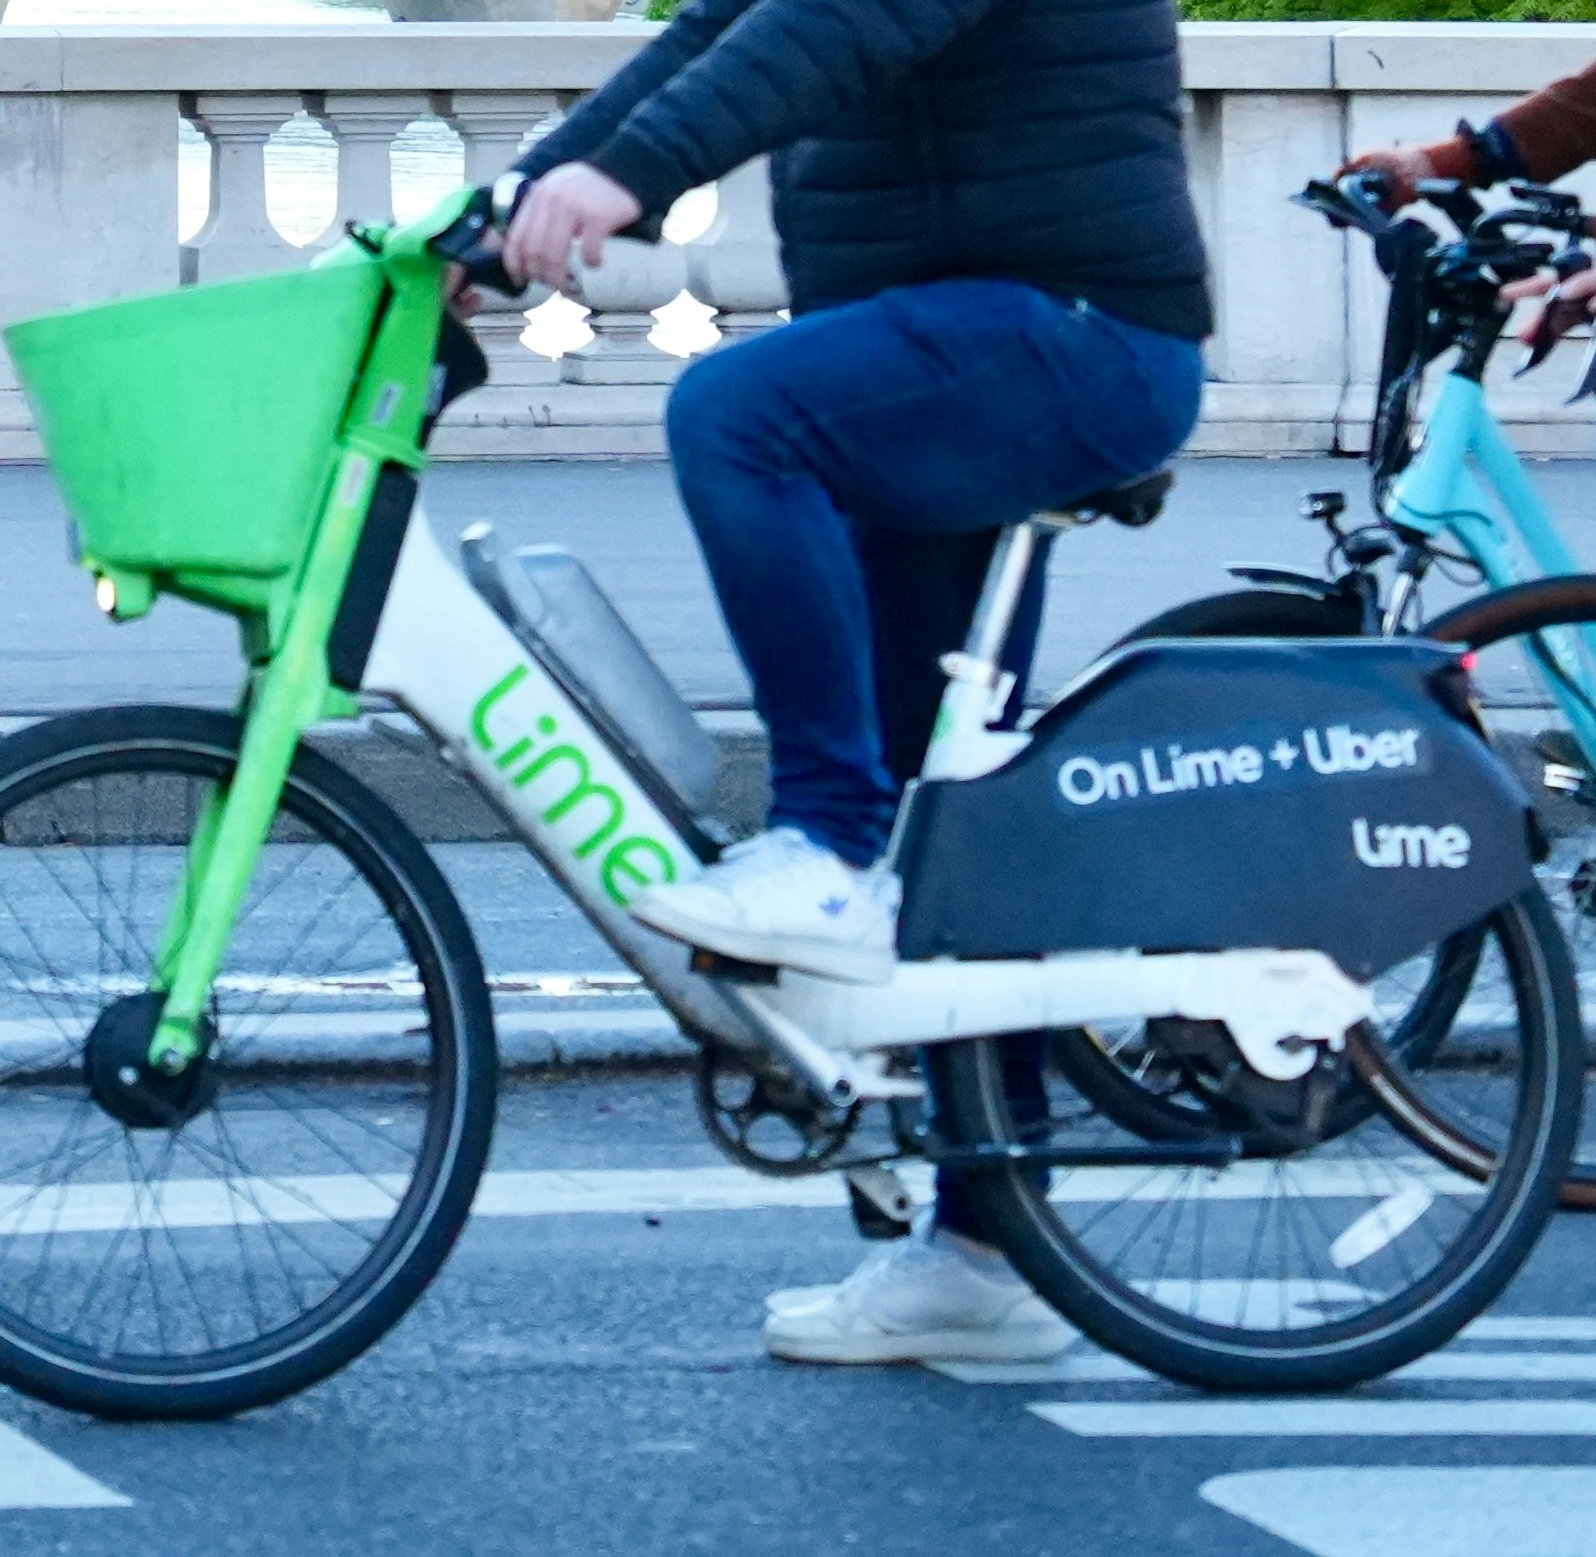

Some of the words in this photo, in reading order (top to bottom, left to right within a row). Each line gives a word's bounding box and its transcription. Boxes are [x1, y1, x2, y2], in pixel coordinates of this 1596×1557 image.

[466, 661, 678, 911] Lime
[1057, 757, 1139, 805] On
[1142, 744, 1263, 795] Lime
[1269, 737, 1300, 771] +
[1303, 726, 1421, 775] Uber
